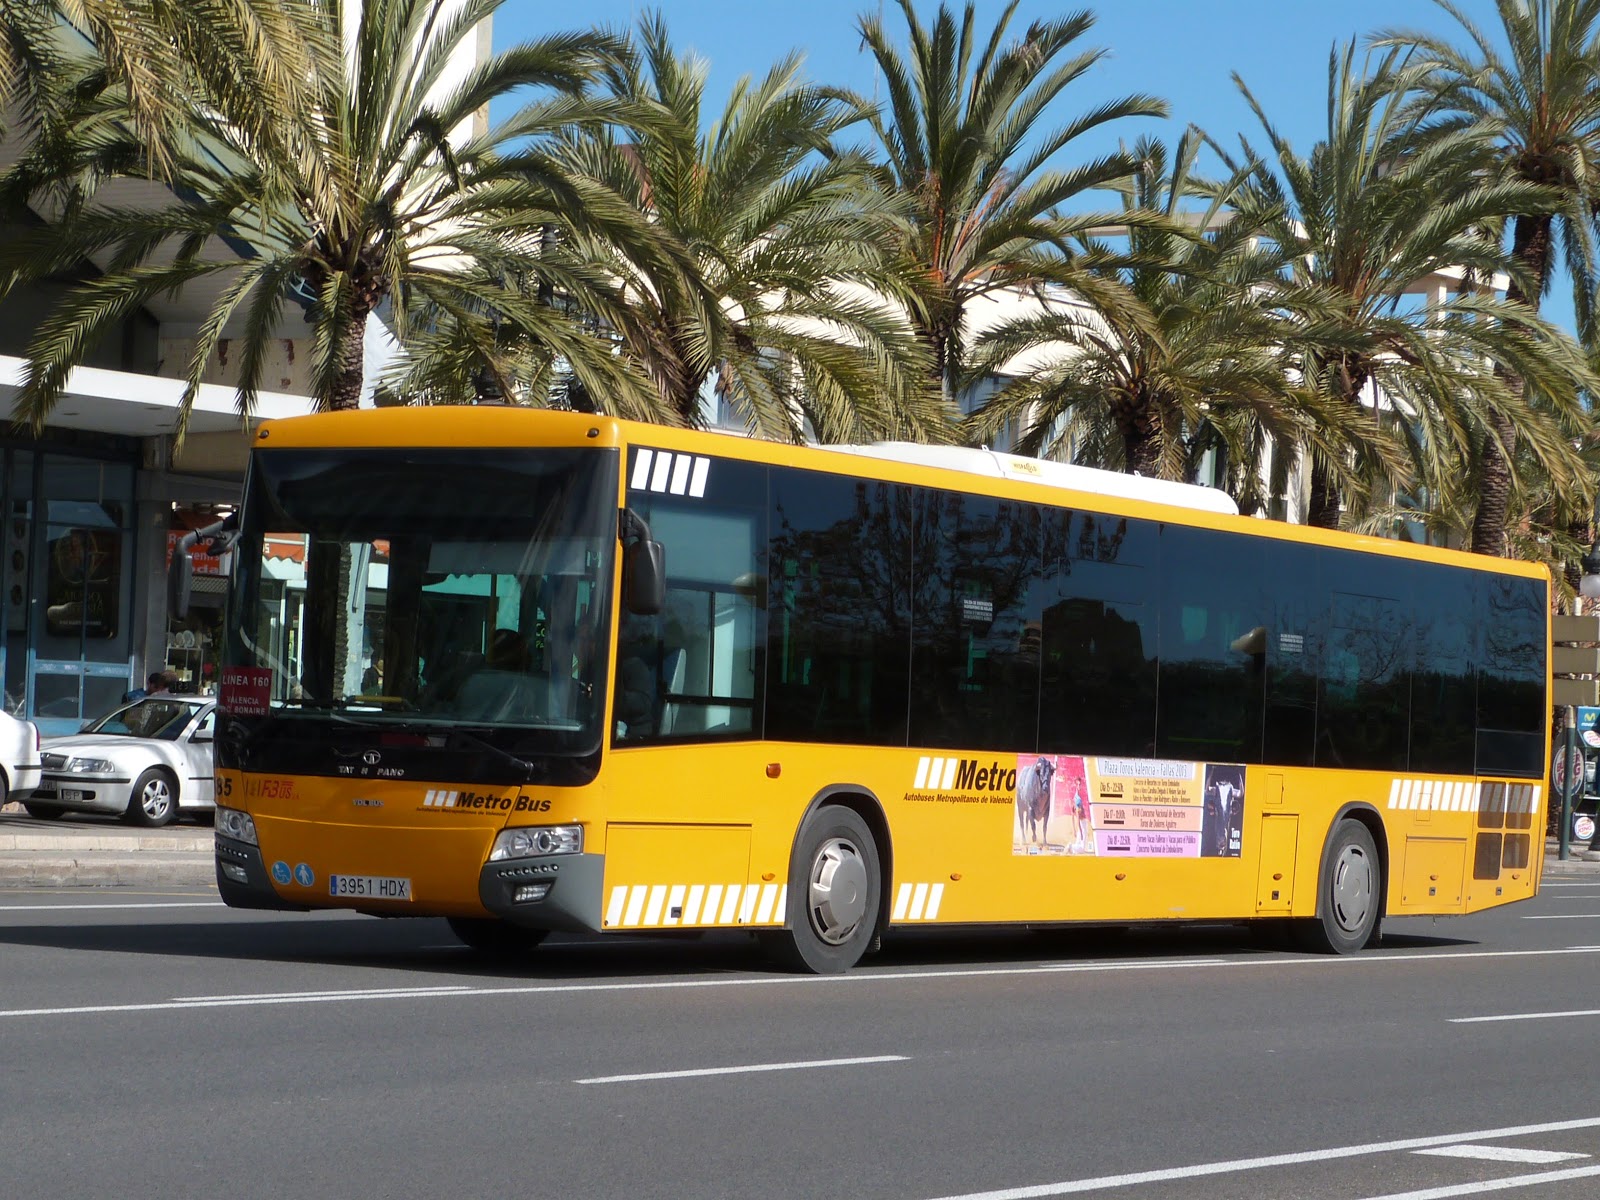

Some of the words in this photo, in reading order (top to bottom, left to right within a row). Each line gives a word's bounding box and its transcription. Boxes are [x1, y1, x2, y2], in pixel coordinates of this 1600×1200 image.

[222, 675, 249, 686] LINEA
[252, 676, 269, 687] 160
[227, 696, 259, 705] VALENCIA
[234, 706, 266, 716] BONAIRE
[1104, 760, 1118, 774] Plaza
[1119, 761, 1133, 775] Toros
[1134, 762, 1156, 776] Valencia
[1160, 763, 1175, 777] Fallas
[955, 759, 1017, 792] Metro
[65, 791, 80, 800] SP
[903, 792, 935, 802] Autobuses
[936, 793, 980, 804] Metropolitanos
[981, 796, 988, 804] de
[989, 795, 1013, 804] Valencia
[340, 878, 372, 895] 3951
[379, 880, 406, 897] HDX
